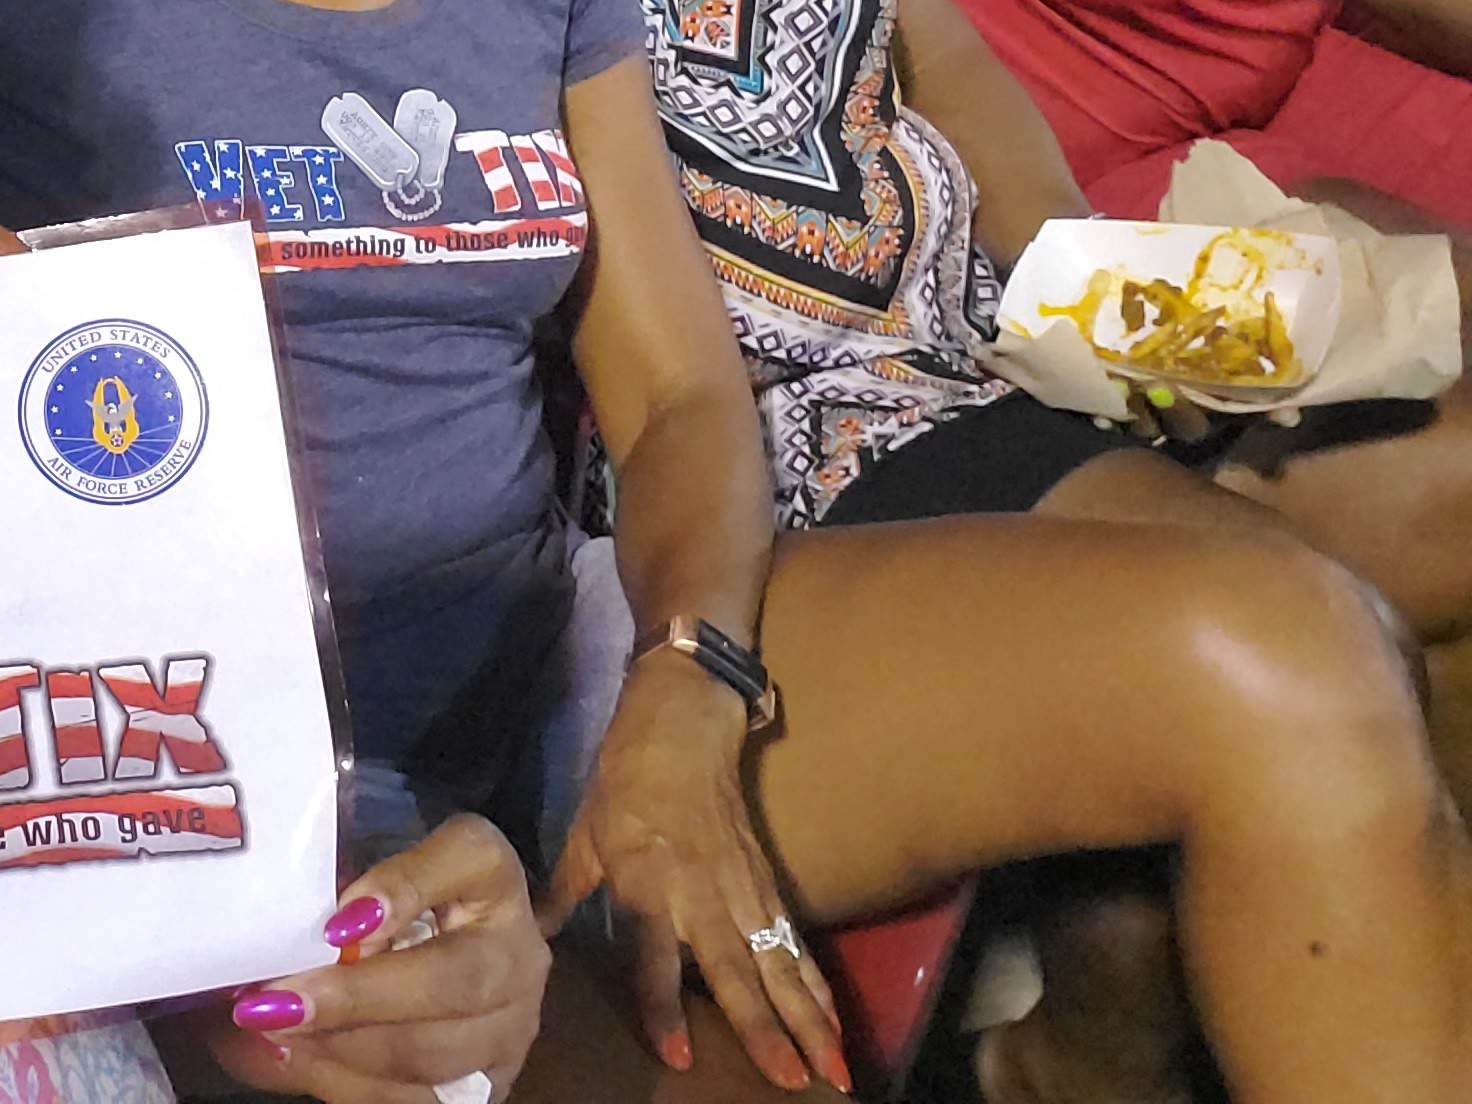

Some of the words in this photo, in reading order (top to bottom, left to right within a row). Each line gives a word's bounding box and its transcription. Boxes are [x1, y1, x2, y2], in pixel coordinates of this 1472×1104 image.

[175, 139, 345, 225] VET
[281, 234, 406, 260] something
[414, 234, 437, 254] to
[445, 230, 509, 251] those
[517, 226, 559, 247] who
[41, 331, 102, 373] UNITED
[110, 329, 171, 359] STATES
[47, 456, 74, 481] AIR
[76, 477, 128, 495] FORCE
[134, 439, 192, 492] RESERVE
[20, 815, 102, 847] who
[117, 807, 208, 844] gave
